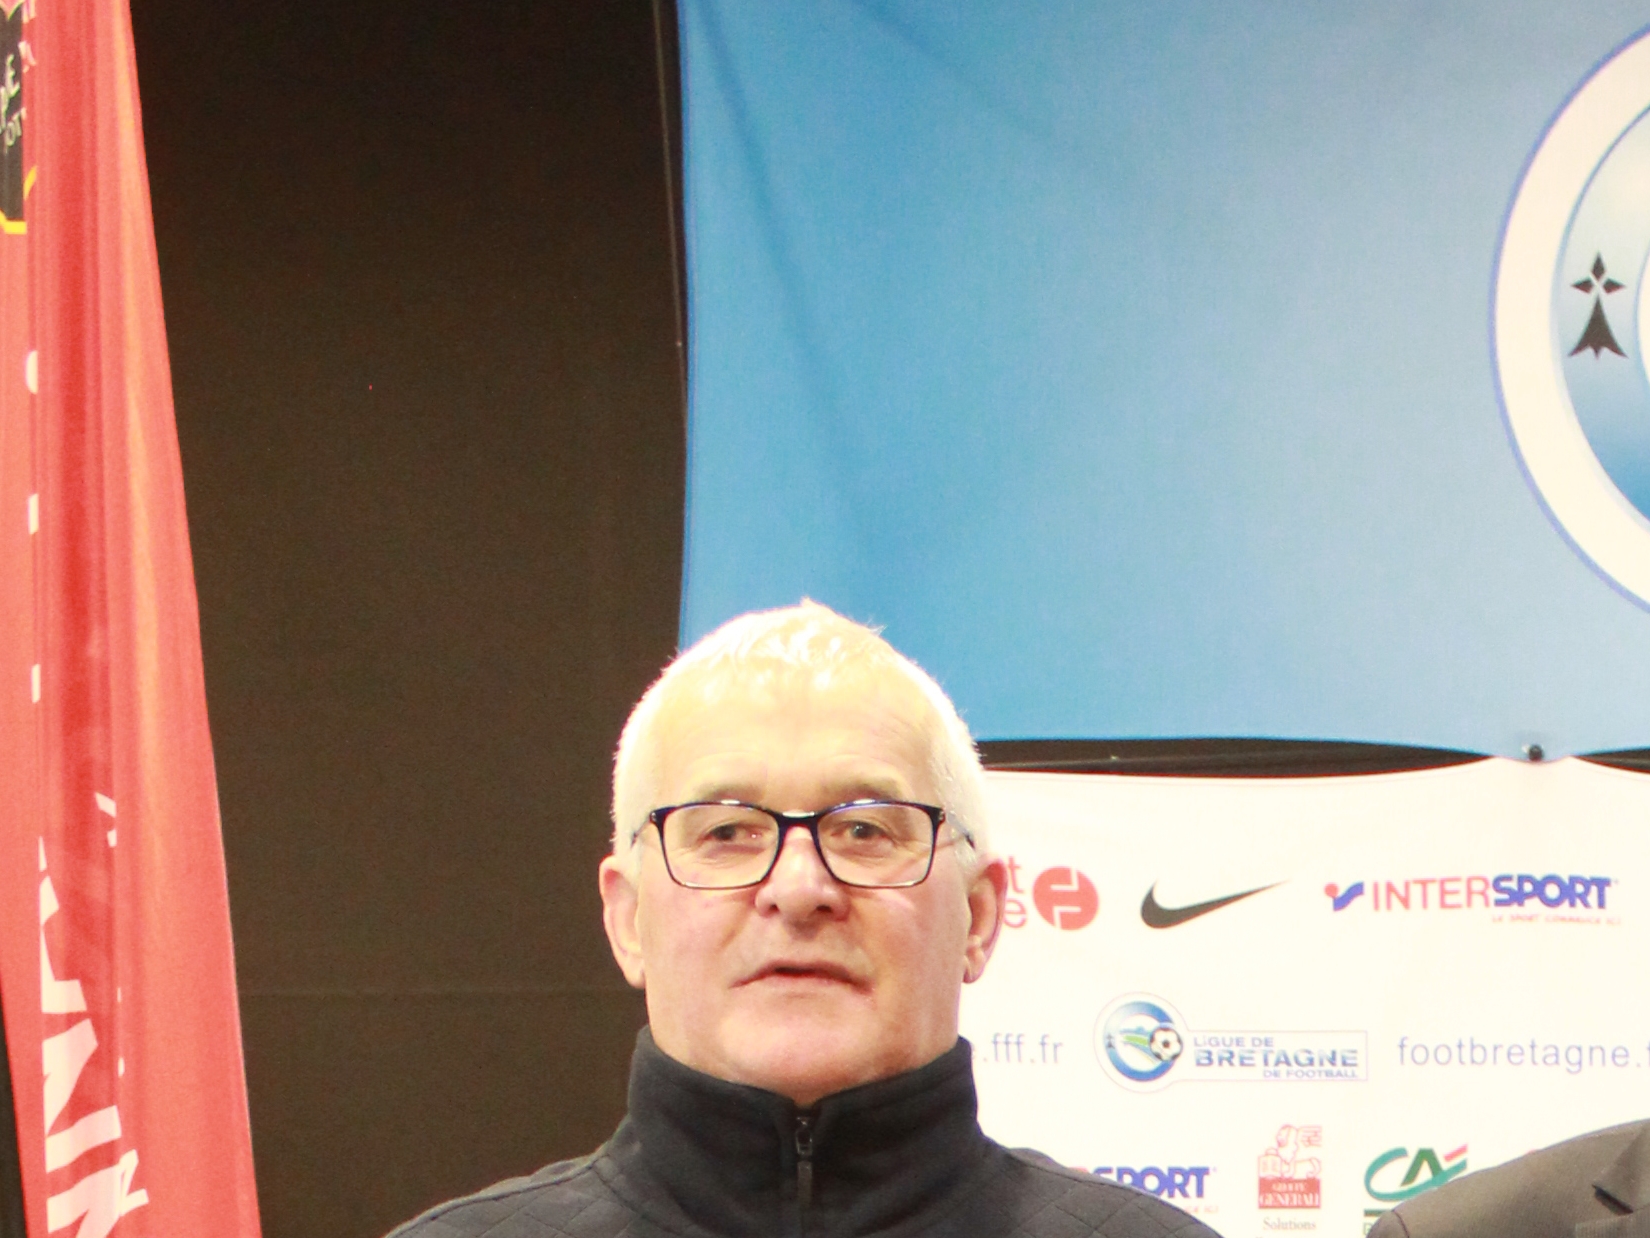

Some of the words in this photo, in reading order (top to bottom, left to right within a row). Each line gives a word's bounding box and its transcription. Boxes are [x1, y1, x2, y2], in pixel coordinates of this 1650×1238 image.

[1372, 874, 1611, 912] INTERSPORT
[1251, 1036, 1275, 1048] DE
[1194, 1048, 1360, 1068] BRETAGNE
[1262, 1069, 1281, 1079] DE
[1285, 1069, 1360, 1079] FOOTBALL
[1262, 1216, 1317, 1231] Solutions
